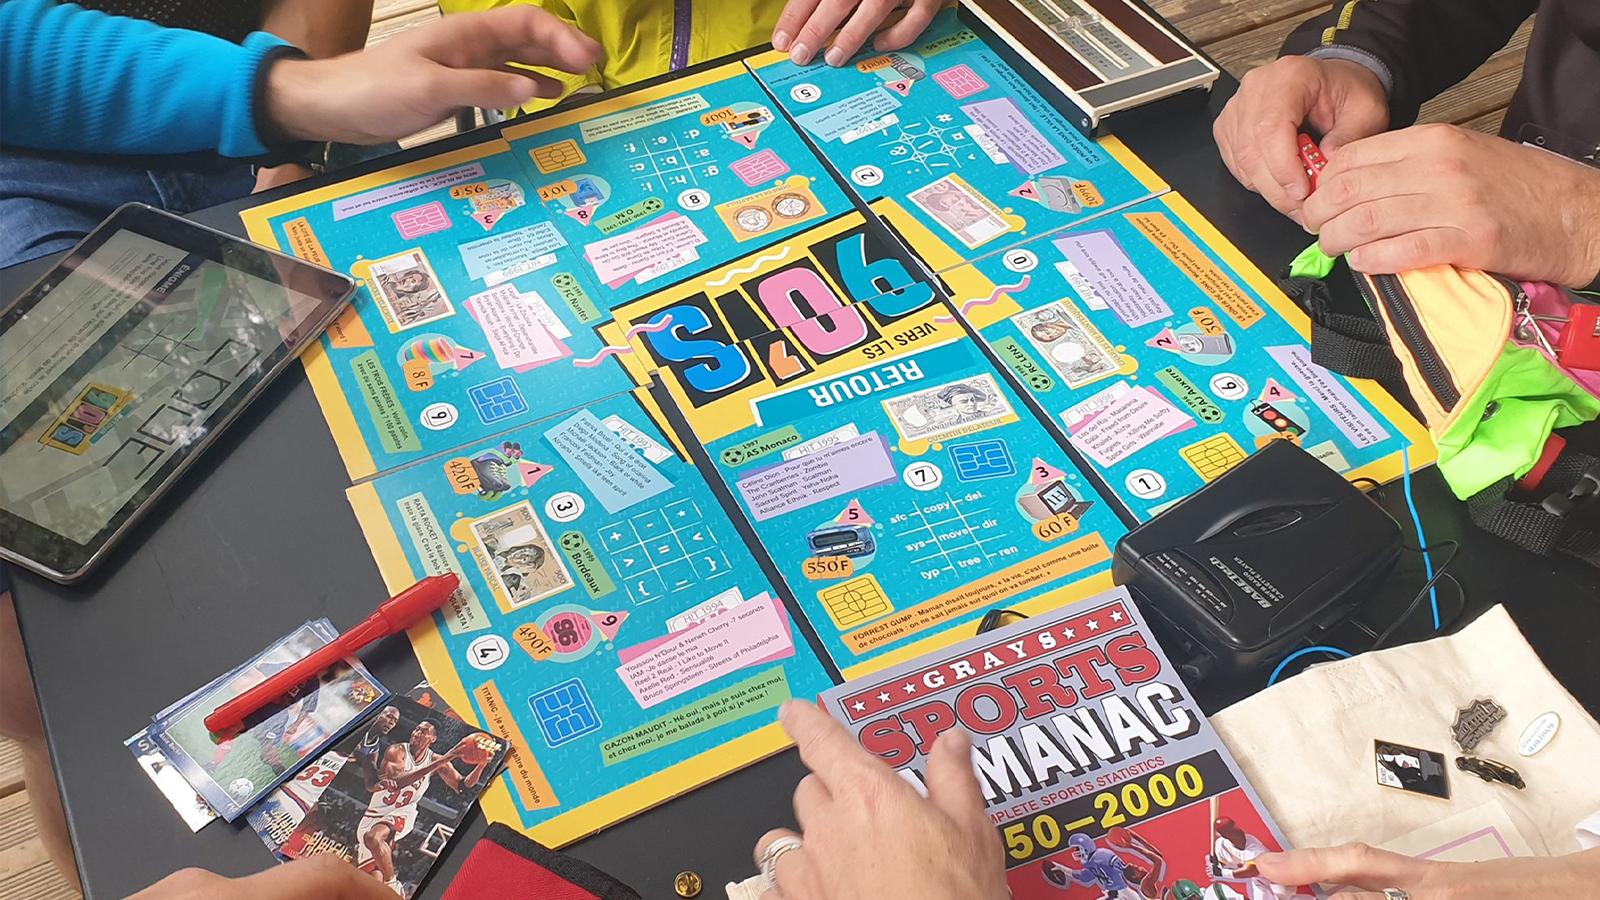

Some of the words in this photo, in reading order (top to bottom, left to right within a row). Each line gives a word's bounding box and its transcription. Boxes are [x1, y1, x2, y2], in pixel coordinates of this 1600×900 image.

[800, 88, 811, 98] 5
[895, 82, 906, 91] 6
[743, 135, 752, 143] 1
[860, 170, 875, 180] 2
[688, 193, 700, 204] 8
[1018, 187, 1032, 199] 2
[483, 214, 493, 224] 3
[576, 209, 588, 219] 8
[562, 288, 574, 298] FC
[569, 297, 589, 321] Nantes
[897, 322, 938, 348] VERS
[862, 337, 894, 359] LES
[1156, 336, 1171, 349] 2
[459, 351, 474, 360] 7
[1006, 343, 1026, 363] LENS
[365, 358, 375, 369] LES
[371, 369, 383, 386] TROIS
[1022, 360, 1037, 374] RC
[808, 359, 925, 408] RETOUR
[1164, 367, 1196, 396] Auxerre
[1220, 380, 1237, 391] 6
[1269, 385, 1280, 397] 4
[431, 410, 447, 420] 9
[745, 448, 759, 458] AS
[760, 433, 797, 452] Monaco
[526, 466, 541, 475] 1
[914, 468, 926, 482] 7
[1035, 465, 1049, 478] 3
[812, 480, 840, 495] Respect
[1138, 477, 1151, 490] 1
[556, 500, 573, 512] 3
[923, 500, 950, 515] copy
[413, 497, 426, 517] RASTA
[421, 516, 438, 540] ROCKET
[849, 508, 858, 519] 5
[982, 518, 998, 530] dir
[939, 527, 969, 541] move
[906, 540, 925, 553] sys
[999, 545, 1018, 556] ren
[958, 555, 981, 569] tree
[571, 552, 600, 593] Bordeaux
[920, 567, 940, 581] typ
[852, 622, 889, 641] FORREST
[889, 613, 912, 626] GUMP
[917, 602, 944, 616] Maman
[944, 593, 965, 605] disait
[964, 582, 997, 598] toujours,
[1041, 555, 1067, 568] comme
[682, 608, 700, 623] HIT
[700, 598, 723, 614] 1994
[737, 604, 764, 620] seconds
[601, 614, 617, 627] 9
[857, 640, 868, 648] de
[868, 626, 903, 644] chocolats
[908, 620, 919, 628] on
[919, 616, 930, 624] ne
[968, 597, 981, 605] sur
[981, 589, 998, 601] quoi
[739, 633, 779, 655] Philadelphia
[479, 646, 497, 658] 4
[923, 631, 1057, 690] GRAYS
[859, 631, 1161, 767] SPORTS
[603, 734, 634, 750] GAZON
[634, 720, 667, 738] MAUDIT
[701, 700, 720, 712] mais
[720, 696, 729, 705] je
[729, 689, 747, 700] suis
[747, 682, 766, 693] chez
[607, 751, 617, 759] et
[617, 743, 636, 755] chez
[655, 732, 664, 741] je
[665, 727, 677, 736] me
[678, 715, 705, 730] balade
[735, 699, 744, 708] je
[745, 692, 764, 703] veux
[480, 686, 498, 713] TITANIC
[498, 723, 510, 739] suis
[519, 769, 529, 779] du
[524, 778, 541, 804] monde
[989, 794, 1039, 825] MPLETE
[1041, 780, 1094, 808] SPORTS
[1095, 756, 1165, 788] STATISTICS
[1004, 762, 1205, 860] 50-2000
